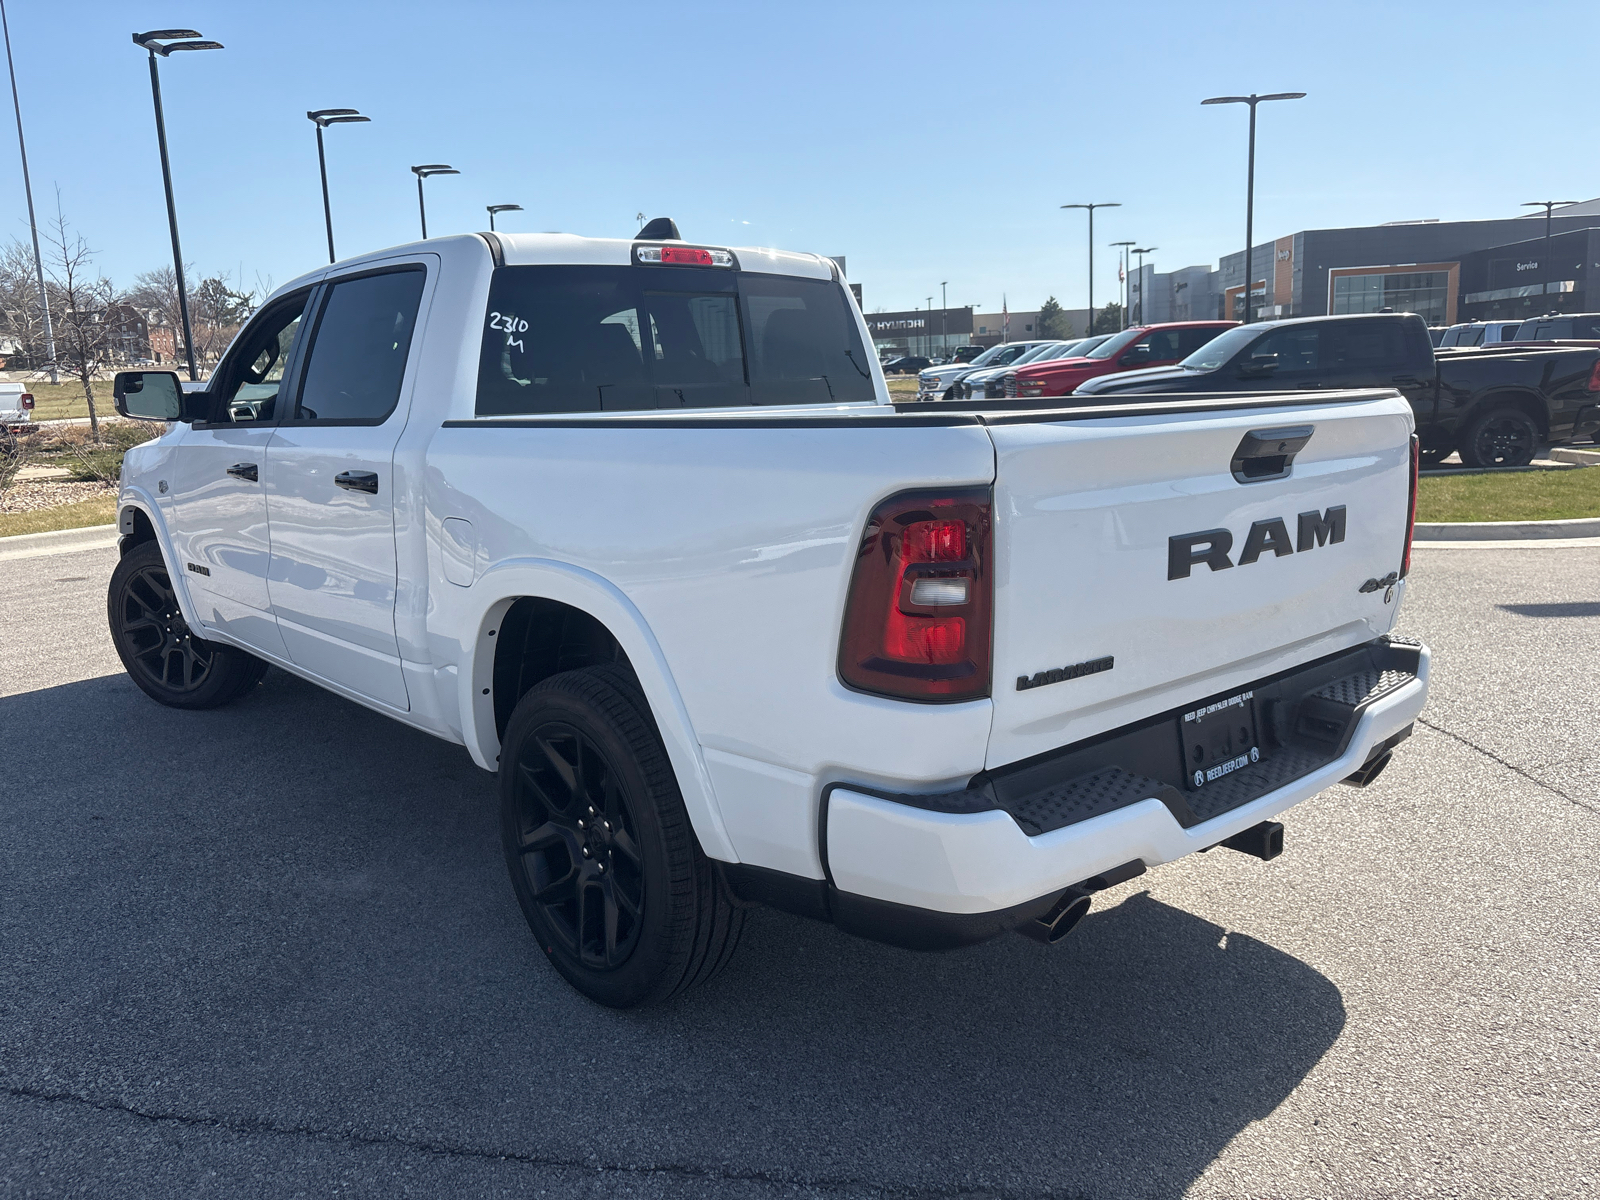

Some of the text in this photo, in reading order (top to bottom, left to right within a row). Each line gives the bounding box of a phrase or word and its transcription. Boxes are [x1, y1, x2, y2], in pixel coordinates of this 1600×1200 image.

[1277, 250, 1290, 261] Jeep
[1516, 261, 1538, 272] Service
[490, 311, 529, 333] 2310
[877, 319, 925, 331] HYUNDAI
[1167, 504, 1347, 581] RAM
[187, 562, 210, 577] RAM
[1016, 655, 1115, 691] LARAMIE
[1185, 691, 1253, 722] REED JEEP CHRYSLER DODGE RAM
[1207, 755, 1249, 781] REEDJEEP.COM
